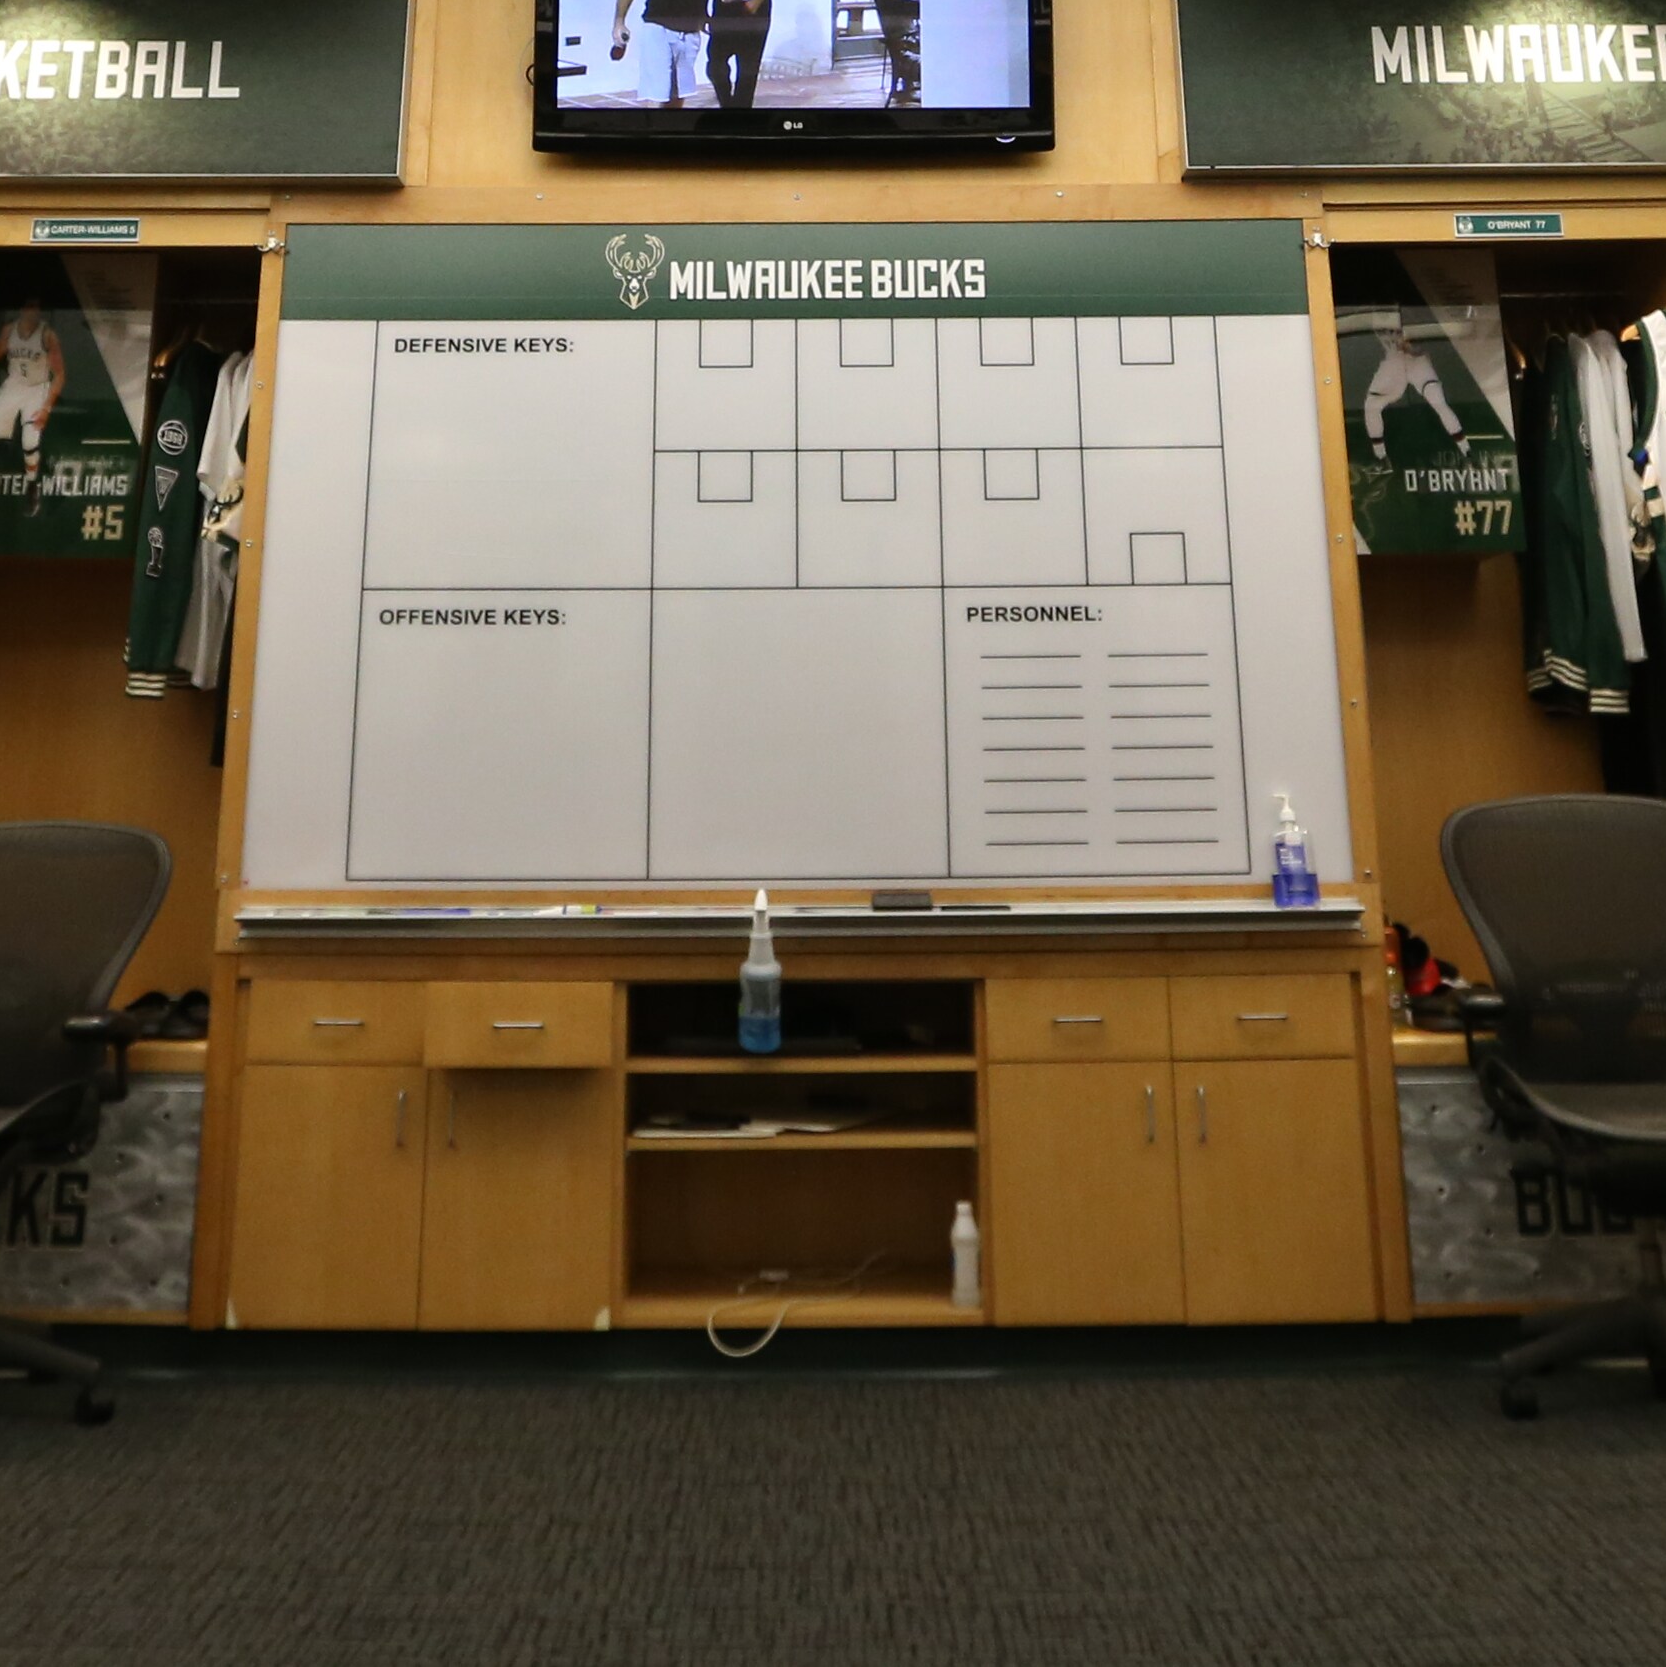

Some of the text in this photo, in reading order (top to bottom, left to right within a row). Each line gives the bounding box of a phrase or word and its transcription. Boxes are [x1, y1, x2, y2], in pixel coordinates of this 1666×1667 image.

[51, 225, 128, 234] CARTER-WILLIAMS
[1487, 220, 1546, 230] O'BRYANT 77
[669, 258, 987, 301] MILWAUKEE BUCKS
[394, 337, 575, 354] DEFENSIVE KEYS:
[1404, 468, 1510, 492] O'BRYANT
[80, 504, 126, 541] #5
[1454, 499, 1513, 536] #77
[379, 608, 567, 626] OFFENSIVE KEYS:
[967, 605, 1103, 623] PERSONNEL:
